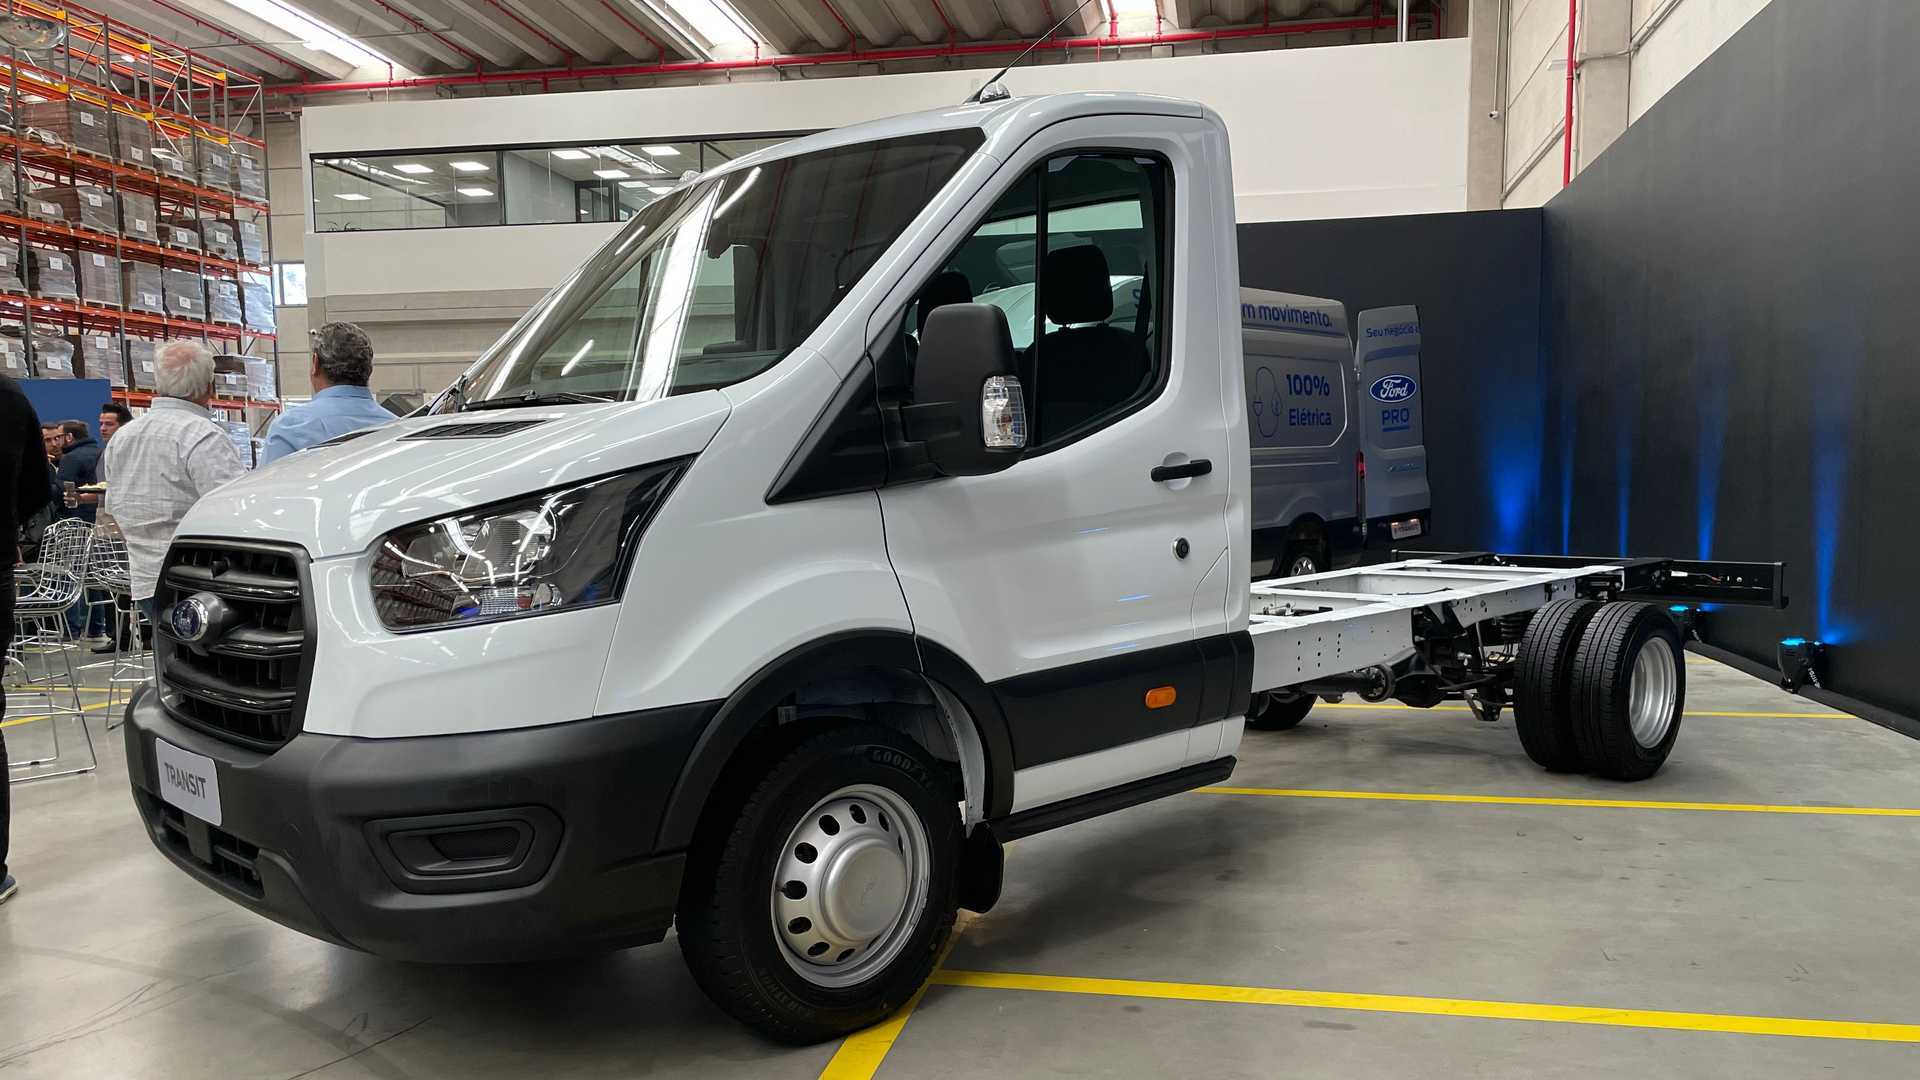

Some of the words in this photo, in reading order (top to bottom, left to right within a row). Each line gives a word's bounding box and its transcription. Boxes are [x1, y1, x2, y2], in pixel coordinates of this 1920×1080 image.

[1241, 303, 1256, 319] m
[1259, 304, 1332, 327] movimento.
[1286, 374, 1330, 396] 100%
[1289, 407, 1332, 426] Elétrica
[1382, 408, 1410, 425] PRO
[164, 762, 207, 799] TRANSIT
